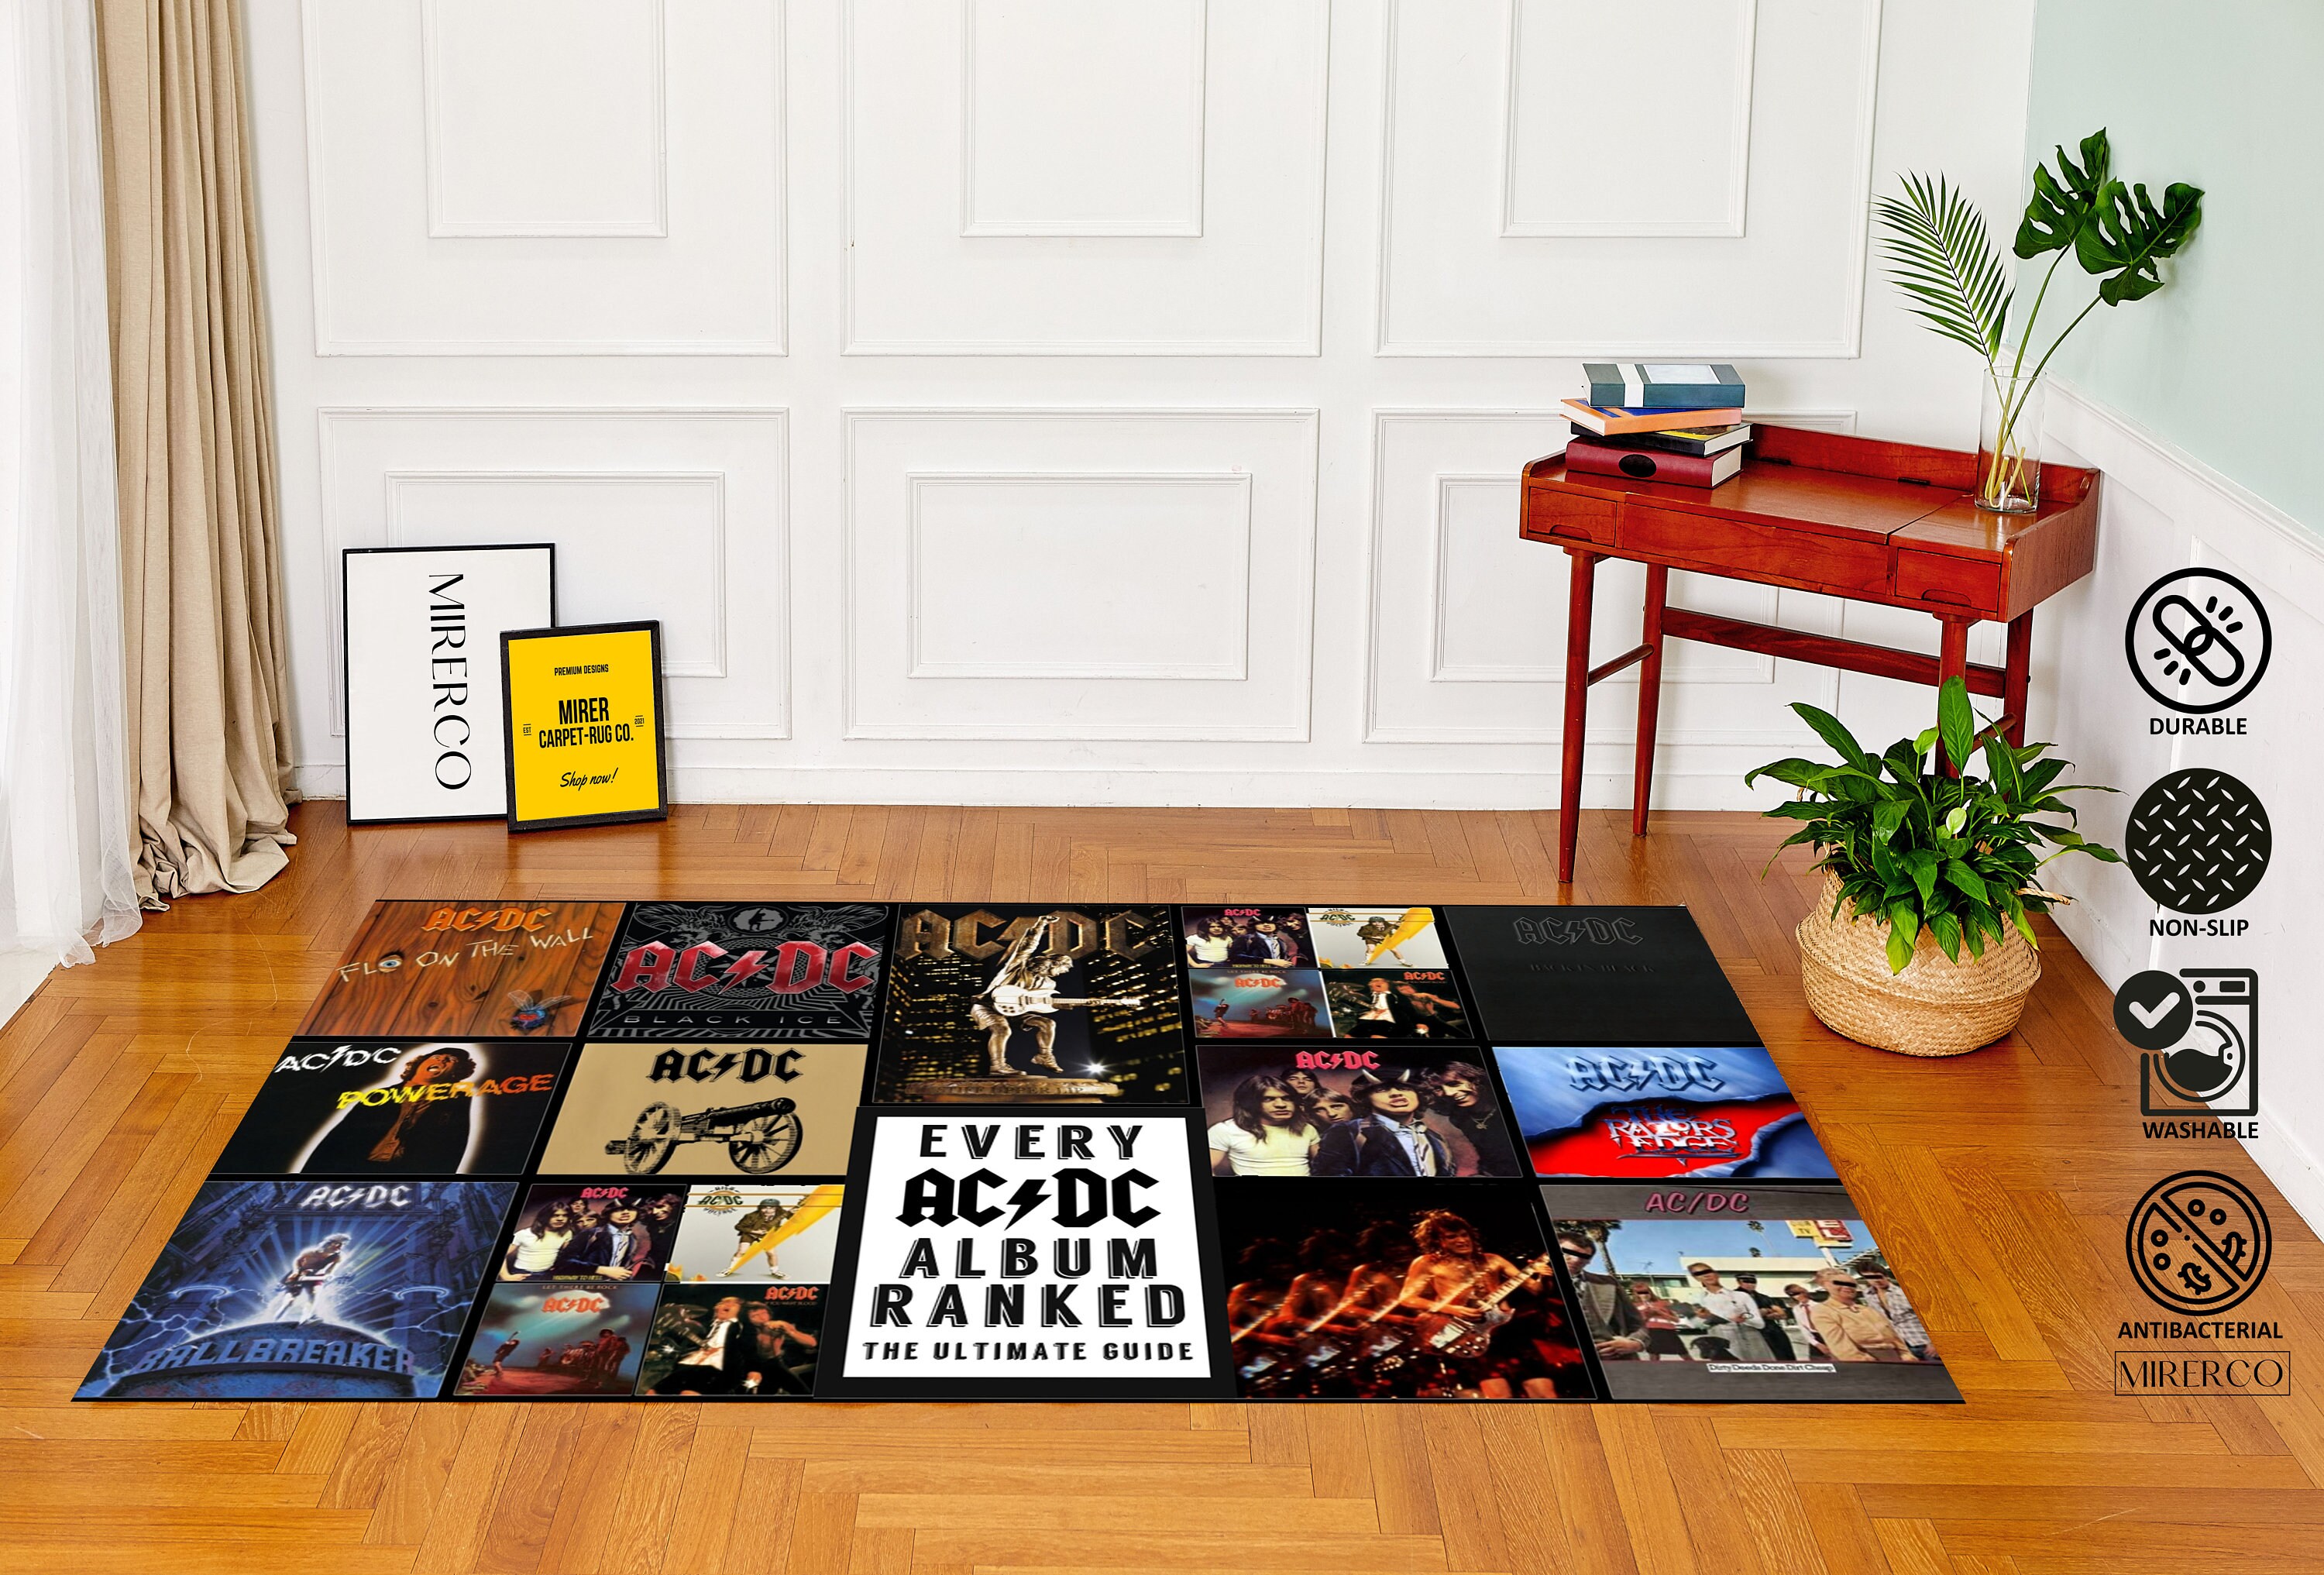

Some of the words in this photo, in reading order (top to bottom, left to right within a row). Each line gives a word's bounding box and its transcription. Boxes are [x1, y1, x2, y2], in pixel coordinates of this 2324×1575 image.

[428, 574, 472, 789] MIRERCO
[554, 665, 583, 676] PREMIUM
[583, 664, 609, 674] DESIGNS
[559, 696, 610, 725] MIRER
[538, 724, 612, 749] CARPET-RUG
[615, 723, 634, 743] CO.
[559, 771, 588, 792] Shop
[590, 767, 619, 785] now!
[421, 906, 552, 932] AC/DC
[415, 951, 459, 968] ON
[466, 939, 519, 958] THE
[530, 927, 593, 950] WALL
[610, 940, 880, 995] AC/DC
[624, 1015, 751, 1024] BLACK
[779, 1015, 841, 1024] ICE
[274, 1045, 401, 1073] AC/DC
[645, 1047, 807, 1084] AC/DC
[1294, 1050, 1382, 1071] AC/DC
[336, 1075, 554, 1109] POWERAGE
[920, 1124, 1143, 1161] EVERY
[301, 1183, 413, 1209] AC/DC
[896, 1167, 1162, 1232] AC/DC
[1644, 1192, 1751, 1214] AC/DC
[899, 1237, 1158, 1280] ALBUM
[869, 1284, 1186, 1328] RANKED
[132, 1337, 415, 1374] BALLBREAKER
[862, 1343, 919, 1360] THE
[933, 1342, 1087, 1361] ULTIMATE
[1102, 1342, 1194, 1361] GUIDE
